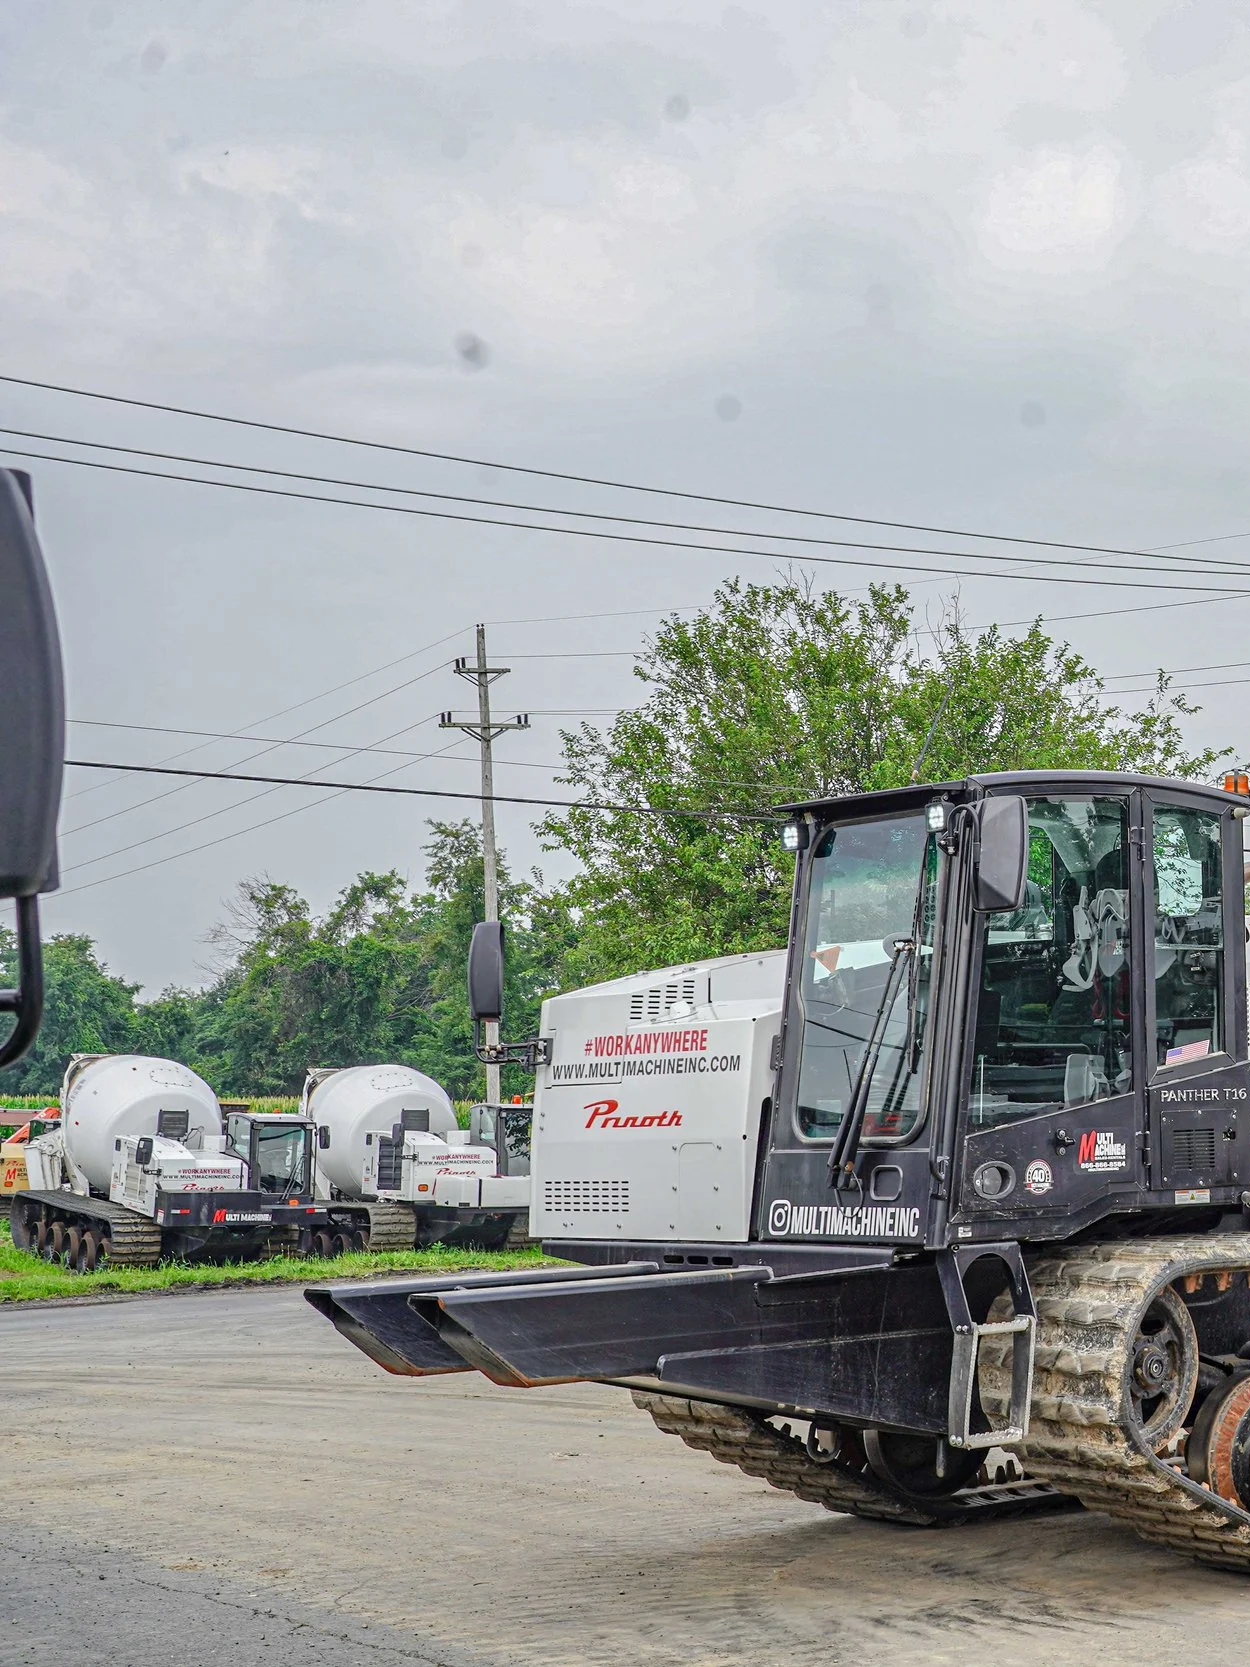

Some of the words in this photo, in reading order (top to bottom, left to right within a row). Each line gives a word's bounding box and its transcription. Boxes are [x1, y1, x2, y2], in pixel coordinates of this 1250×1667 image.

[584, 1029, 709, 1057] #WORKANYWHERE
[552, 1054, 741, 1080] WWW.MULTIMACHINEINC.COM
[1161, 1089, 1220, 1102] PANTHER
[1223, 1088, 1247, 1100] T16
[584, 1099, 683, 1129] Prinoth
[1032, 1169, 1044, 1182] 40
[790, 1206, 920, 1237] MULTIMACHINEINC
